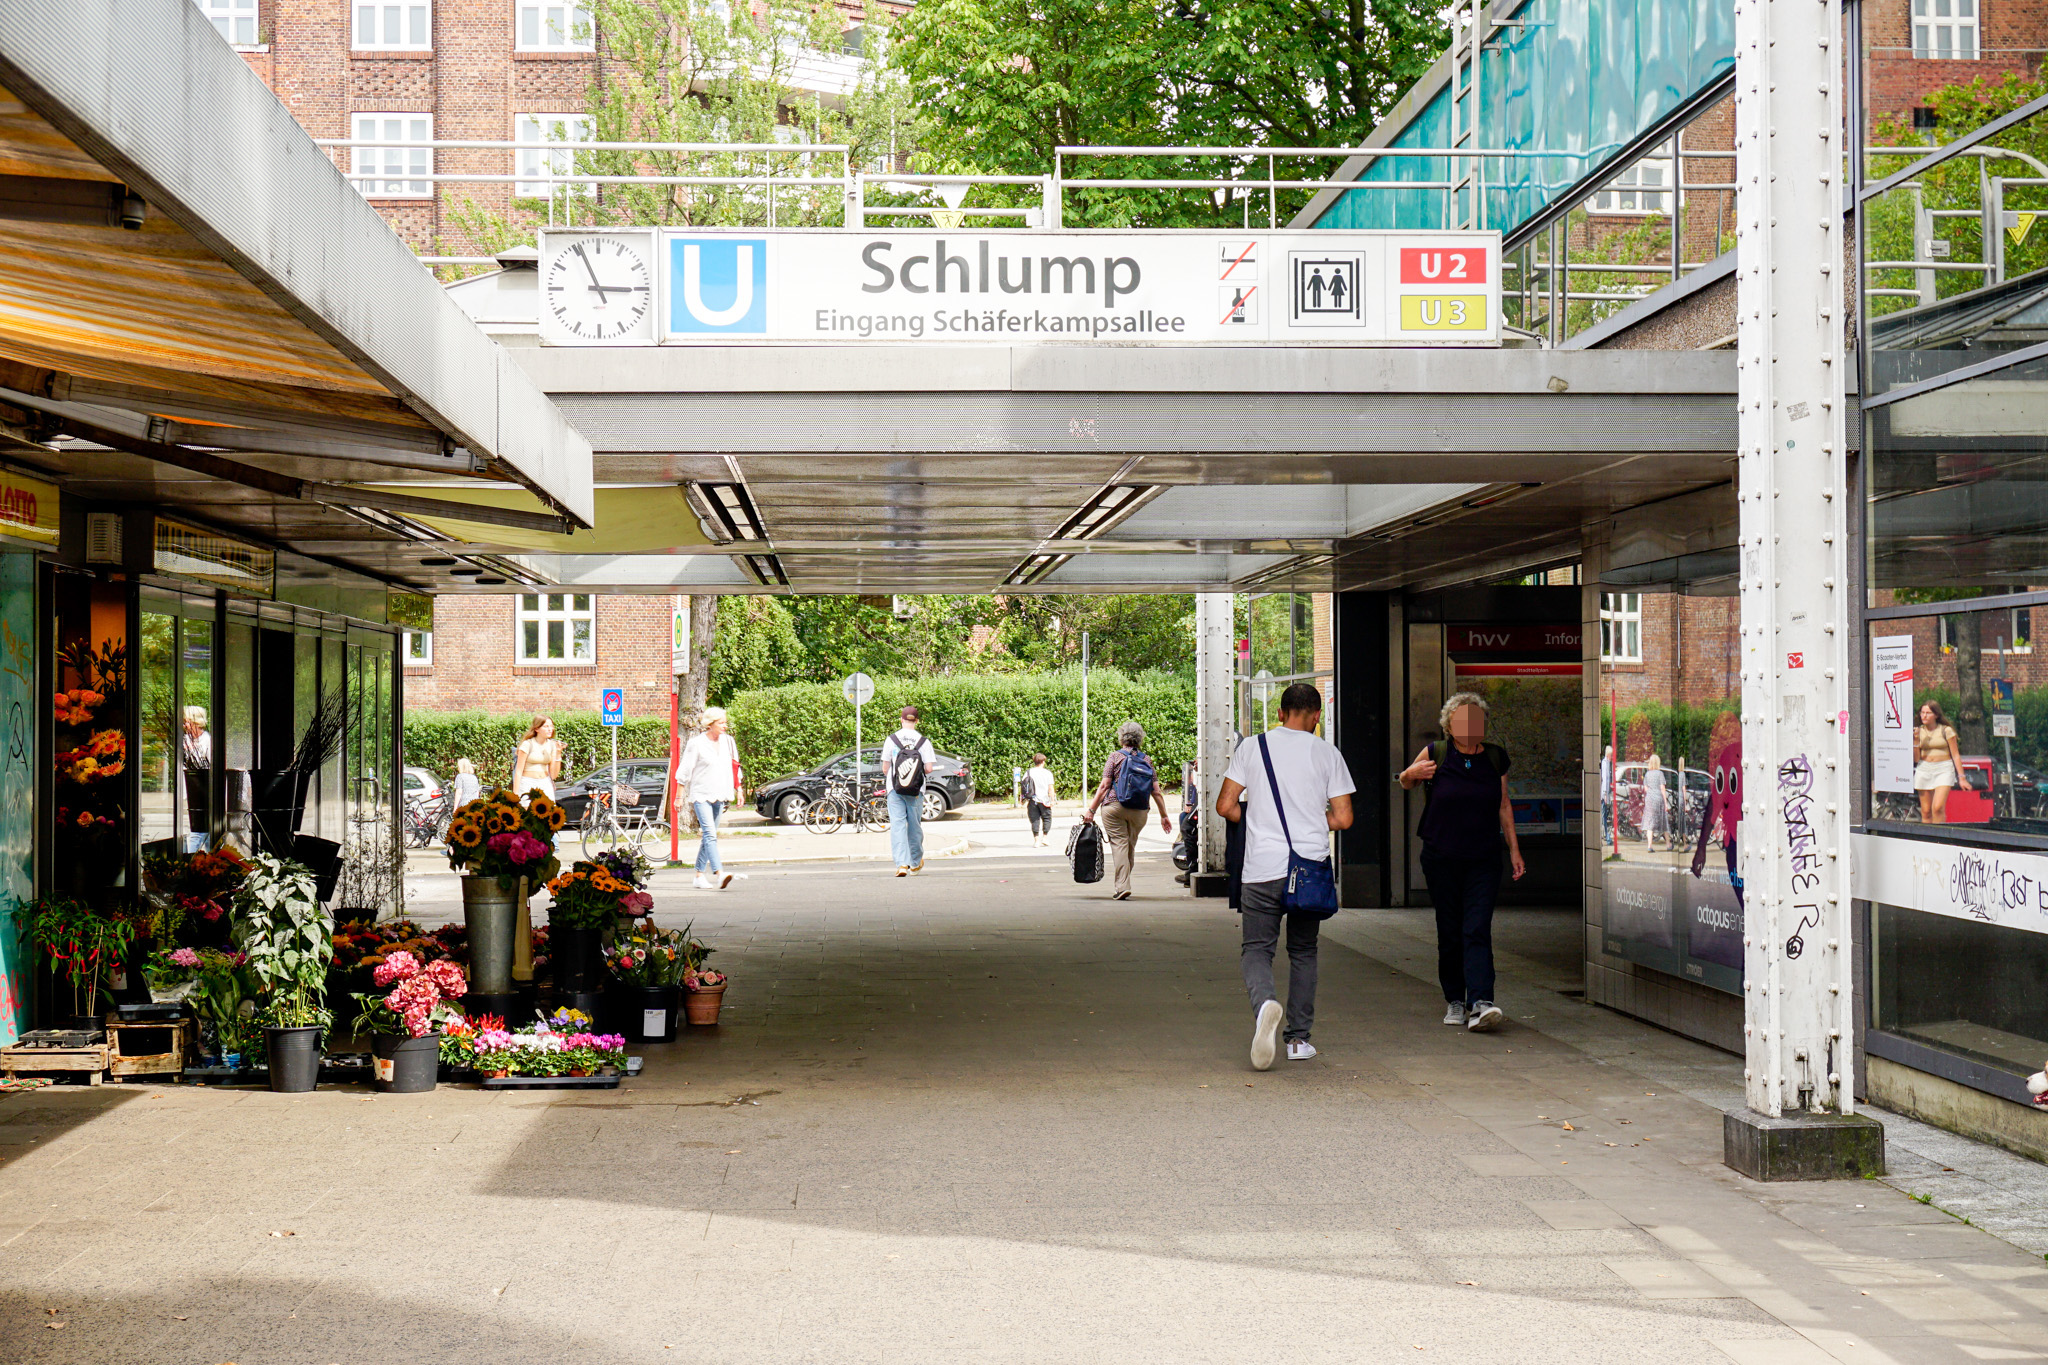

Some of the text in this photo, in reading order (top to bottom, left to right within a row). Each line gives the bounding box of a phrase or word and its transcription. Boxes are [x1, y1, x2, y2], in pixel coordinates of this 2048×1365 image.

[861, 239, 1142, 309] Schlump
[684, 244, 753, 327] U
[815, 308, 1186, 339] Eingang Schäferkampsallee
[1469, 631, 1511, 647] hvv
[1545, 633, 1582, 645] Infor
[604, 714, 622, 724] TAXI
[1719, 867, 1744, 888] wechs
